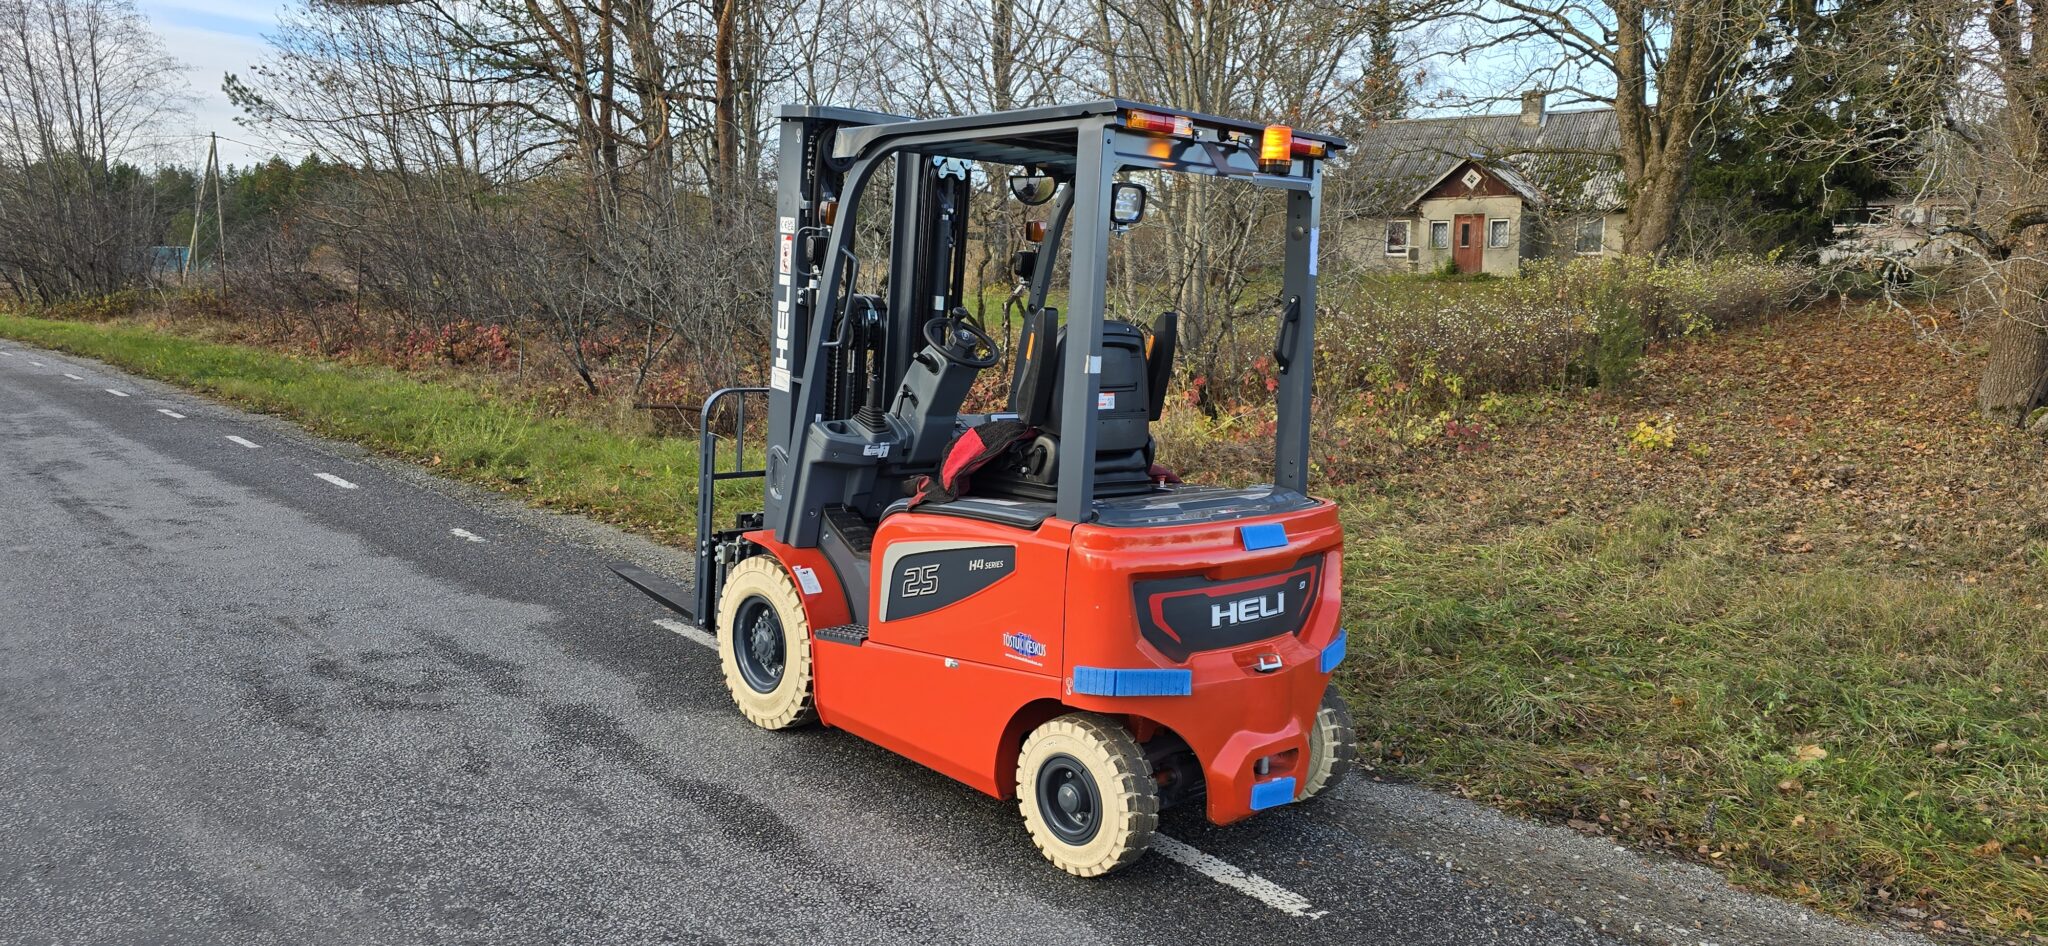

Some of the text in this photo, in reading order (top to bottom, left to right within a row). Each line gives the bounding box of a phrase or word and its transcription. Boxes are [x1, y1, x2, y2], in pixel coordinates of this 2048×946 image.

[775, 274, 791, 370] HELI
[902, 563, 941, 598] 25
[969, 559, 1004, 571] H4 SERIES
[1211, 591, 1285, 628] HELI
